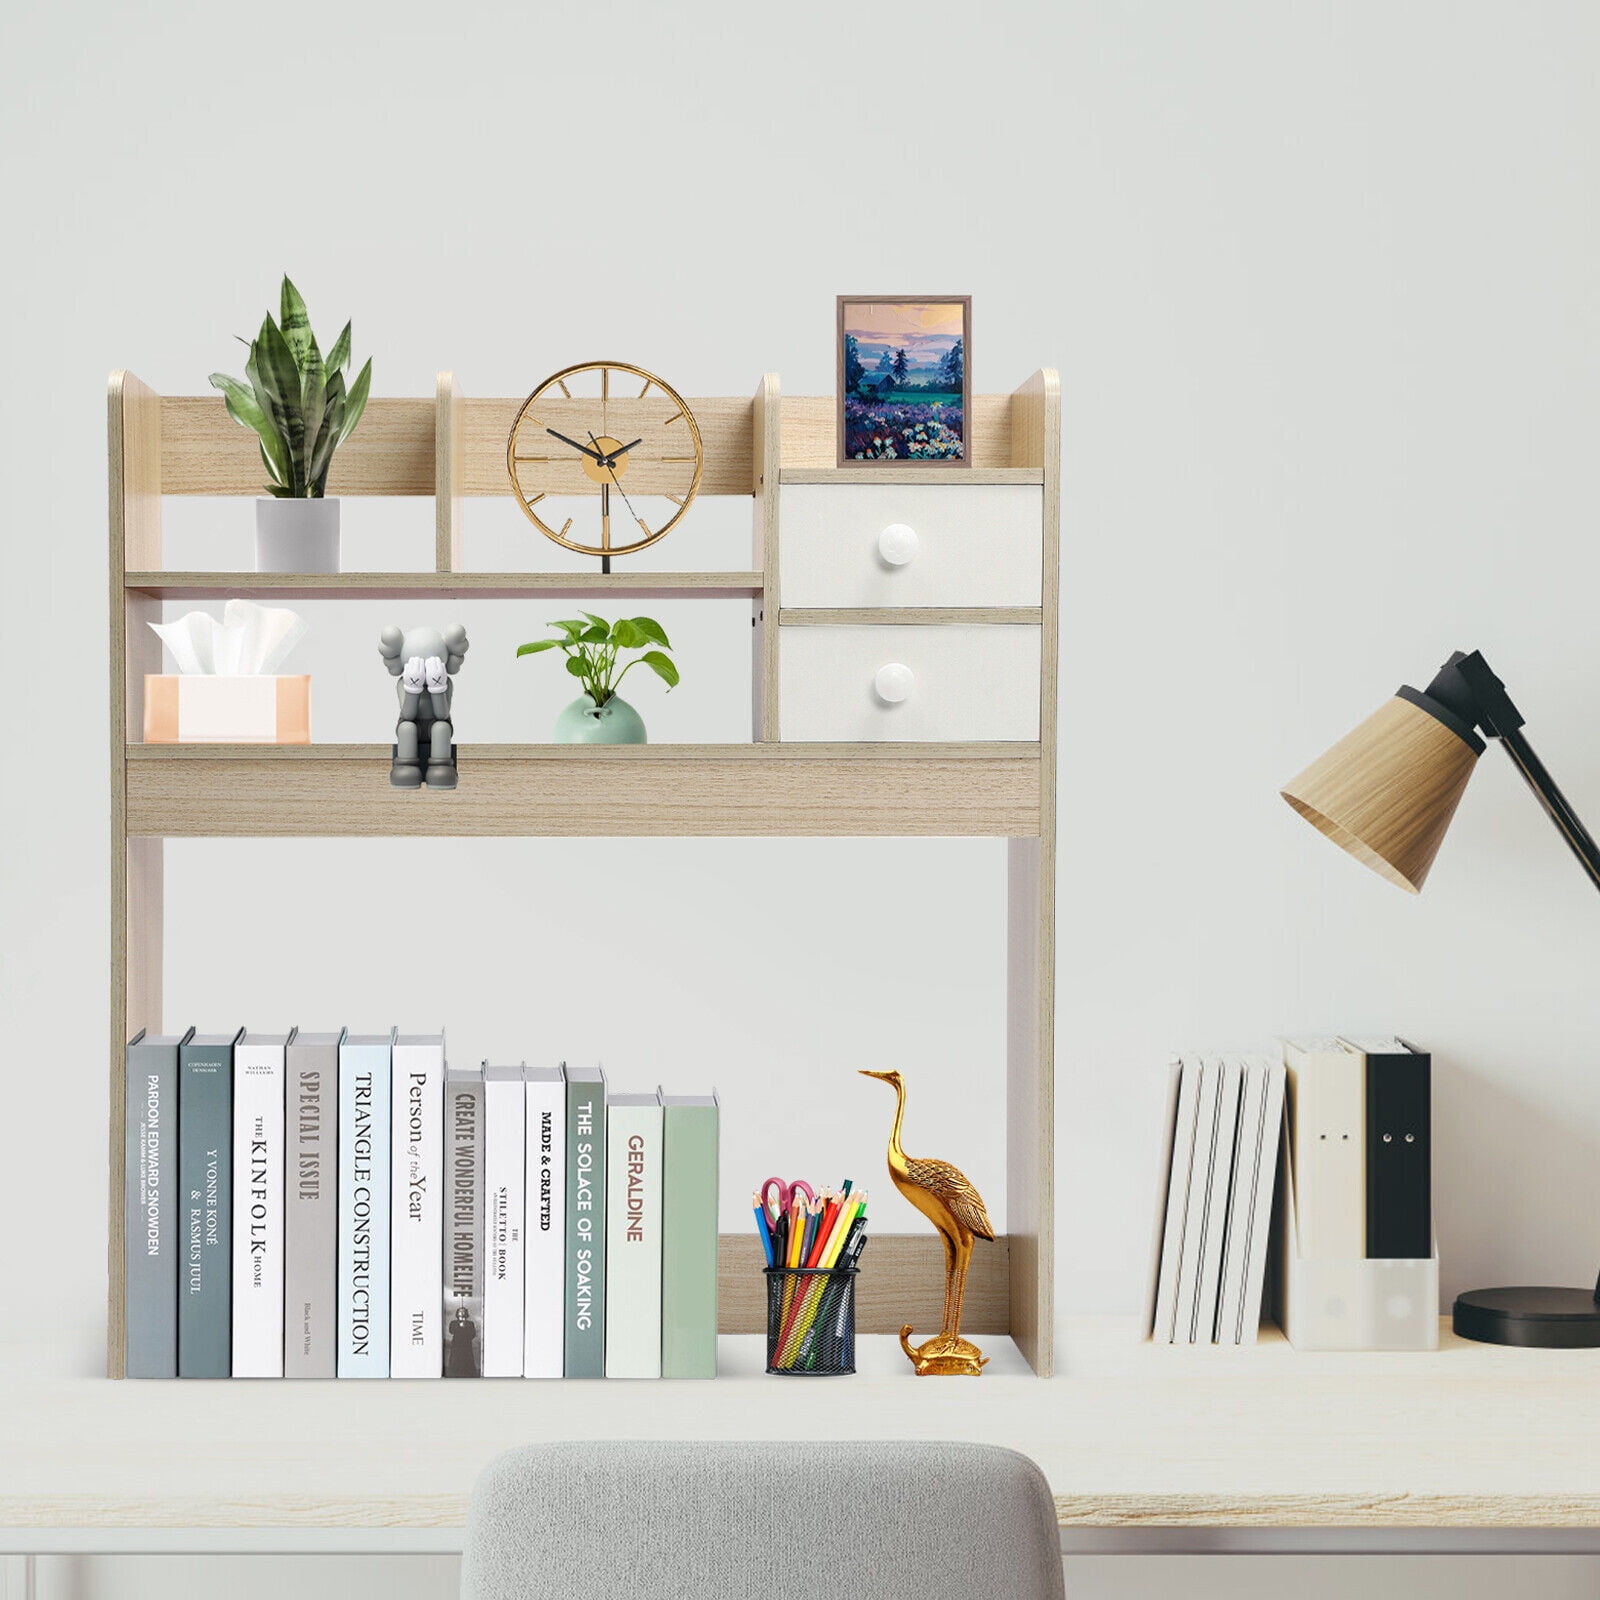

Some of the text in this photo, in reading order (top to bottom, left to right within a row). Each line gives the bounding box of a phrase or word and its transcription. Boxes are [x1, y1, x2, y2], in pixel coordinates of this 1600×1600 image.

[147, 1075, 159, 1256] PARDON EDWARD SNOWDEN
[299, 1072, 320, 1200] SPECIAL ISSUE
[407, 1072, 426, 1222] Person of the Year
[453, 1094, 476, 1297] CREATE WONDERFUL HOMELIFE
[540, 1112, 551, 1231] MADE & CRAFTED
[627, 1135, 643, 1242] GERALDINE
[190, 1191, 201, 1294] & RASMUS JUUL
[206, 1209, 218, 1245] KONÉ
[250, 1116, 267, 1288] THE KINFOLK HOME
[352, 1072, 372, 1355] TRIANGLE CONSTRUCTION
[498, 1187, 507, 1280] STILETTO BOOK
[577, 1102, 591, 1330] THE SOLACE OF SOAKING
[412, 1311, 424, 1346] TIME
